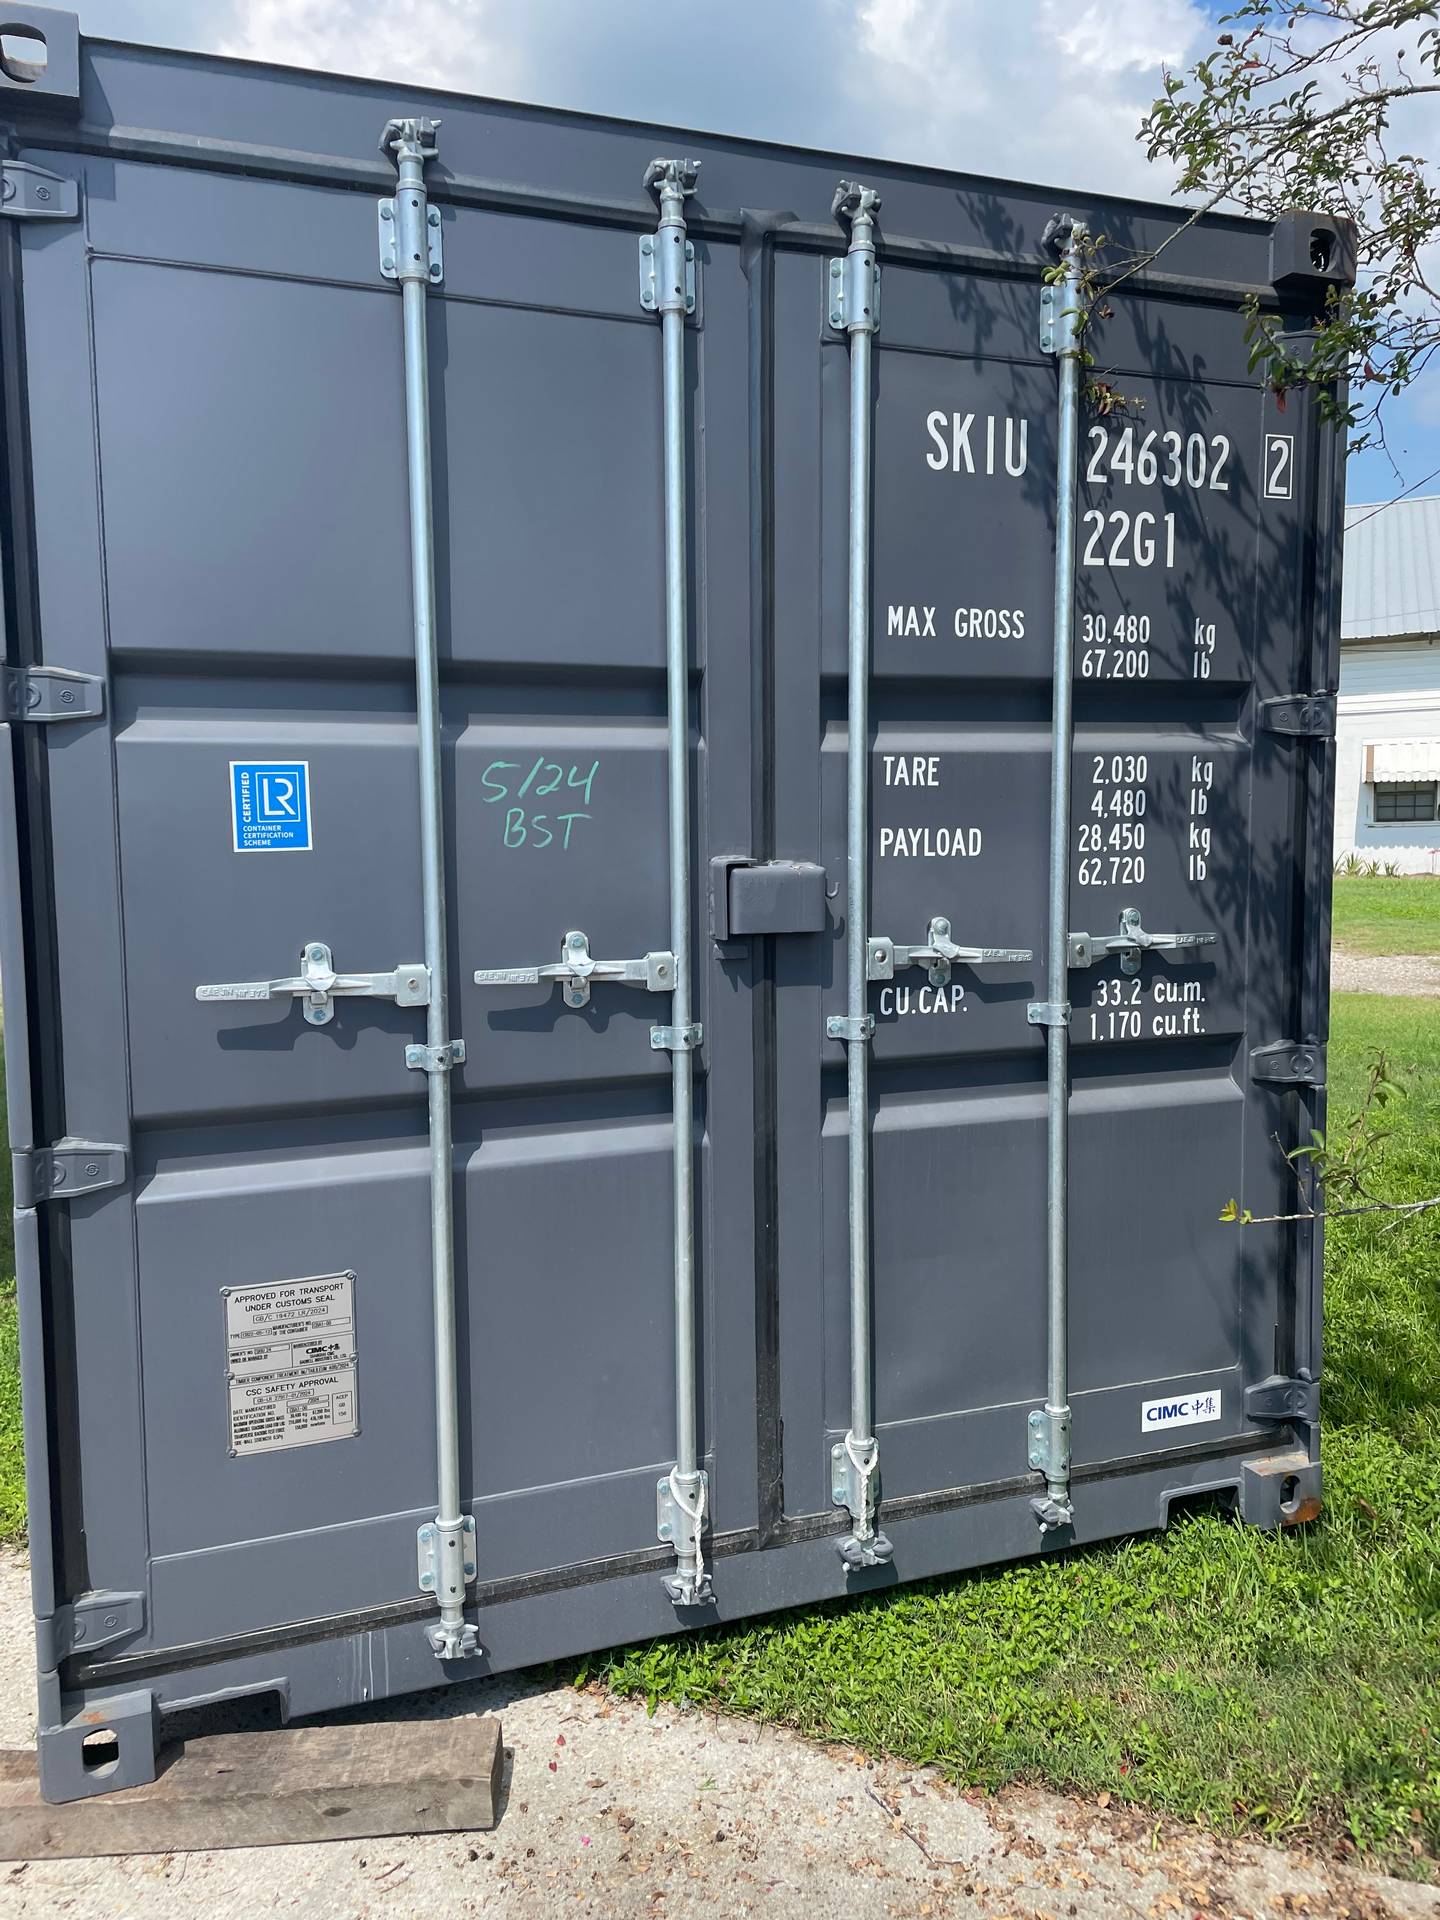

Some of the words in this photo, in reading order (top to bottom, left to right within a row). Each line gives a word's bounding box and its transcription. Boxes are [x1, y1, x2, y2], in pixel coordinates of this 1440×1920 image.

[927, 411, 1027, 476] SKIU
[1087, 426, 1229, 490] 246302
[1268, 439, 1289, 495] 2
[1084, 510, 1174, 567] 22G1
[888, 606, 936, 636] MAX
[955, 608, 1024, 638] GROSS
[1083, 615, 1149, 644] 30,480
[1194, 617, 1216, 652] kg
[1082, 649, 1148, 678] 67,200
[1193, 650, 1211, 679] lb
[482, 756, 600, 804] 5/24
[884, 757, 939, 785] TARE
[1093, 756, 1147, 784] 2,030
[1191, 756, 1213, 790] kg
[241, 771, 251, 823] CERTIFIED
[263, 777, 296, 816] LR
[1091, 790, 1145, 818] 4,480
[1190, 789, 1208, 815] lb
[243, 824, 282, 832] CONTAINER
[243, 831, 294, 840] CERTIFICATION
[243, 839, 271, 847] SCHEME
[504, 807, 592, 850] BST
[881, 828, 981, 856] PAYLOAD
[1079, 823, 1144, 852] 28,450
[1189, 824, 1211, 856] kg
[1079, 857, 1144, 885] 62,720
[1189, 855, 1207, 881] lb
[880, 985, 967, 1015] CU.CAP.
[1096, 979, 1142, 1006] 33.2
[1154, 982, 1205, 1003] cu.m.
[1090, 1012, 1141, 1041] 1,170
[1152, 1010, 1205, 1035] cu.ft.
[234, 1292, 276, 1304] APPROVED
[280, 1289, 295, 1298] FOR
[300, 1282, 344, 1295] TRANSPORT
[245, 1303, 271, 1312] UNDER
[276, 1297, 312, 1308] CUSTOMS
[315, 1294, 335, 1303] SEAL
[306, 1346, 327, 1354] CIMC
[246, 1388, 262, 1397] CSC
[265, 1383, 295, 1393] SAFETY
[299, 1376, 338, 1388] APPROVAL
[1147, 1403, 1189, 1421] CIMC
[1192, 1397, 1215, 1415] 中集
